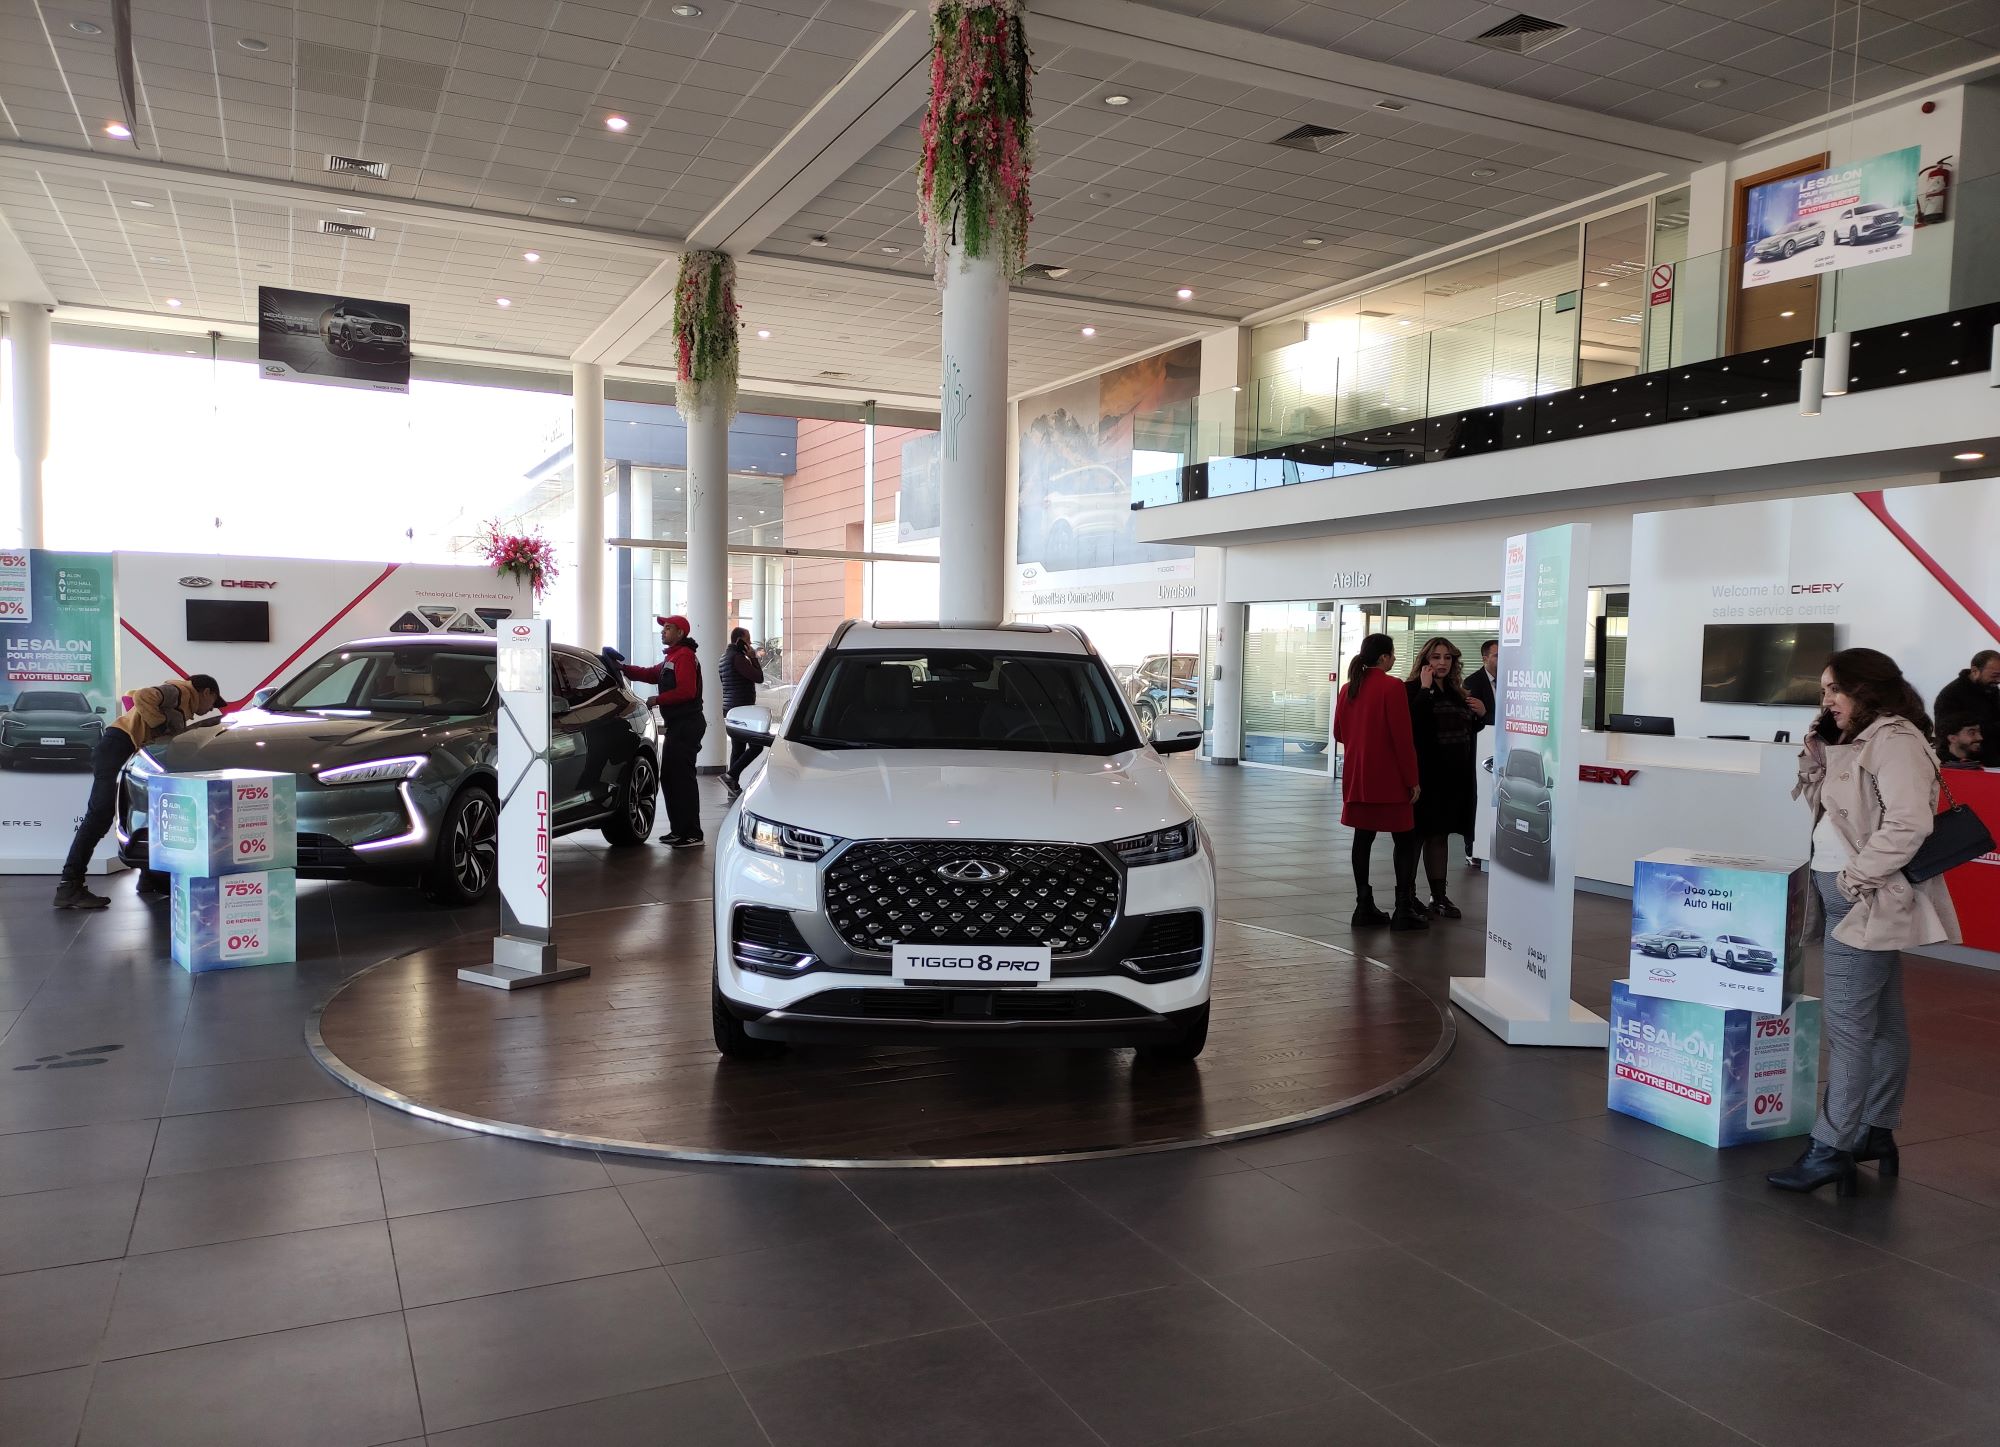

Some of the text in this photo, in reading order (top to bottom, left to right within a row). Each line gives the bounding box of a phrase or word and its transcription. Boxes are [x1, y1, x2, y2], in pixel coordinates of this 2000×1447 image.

[1816, 168, 1862, 187] SALON
[1508, 546, 1524, 565] 75%
[221, 579, 278, 589] CHERY
[1333, 570, 1372, 589] Atelier
[415, 590, 454, 598] Technological
[1158, 584, 1196, 600] Livraison
[1711, 582, 1844, 598] Welcome to CHERY
[1711, 602, 1841, 618] sales service center
[1505, 616, 1519, 634] 0%
[30, 639, 92, 652] SALON
[7, 661, 27, 671] LA
[1507, 670, 1551, 689] LE SALON
[1506, 690, 1520, 700] POUR
[1505, 703, 1516, 717] LA
[1505, 720, 1547, 735] ET VOTRE BUDGET
[1579, 764, 1640, 786] ERY
[237, 786, 269, 801] 75%
[240, 838, 266, 854] 0%
[537, 790, 547, 897] CHERY
[224, 882, 262, 897] 75%
[1684, 898, 1732, 912] Auto Hall
[228, 934, 260, 950] 0%
[1488, 931, 1513, 950] SERES
[907, 955, 1040, 972] TIGGO 8 PRO
[1526, 959, 1546, 980] Auto Hall
[1648, 976, 1676, 984] CHERY
[1719, 981, 1765, 993] SERES
[1755, 1018, 1790, 1038] 75%
[1616, 1016, 1715, 1060] LE SALON
[1616, 1035, 1645, 1053] POUR
[1616, 1048, 1636, 1066] LA
[1755, 1059, 1786, 1071] OFFRE
[1763, 1069, 1787, 1077] REPRISE
[1617, 1065, 1710, 1104] ET VOTRE BUDGET
[1754, 1092, 1784, 1115] 0%
